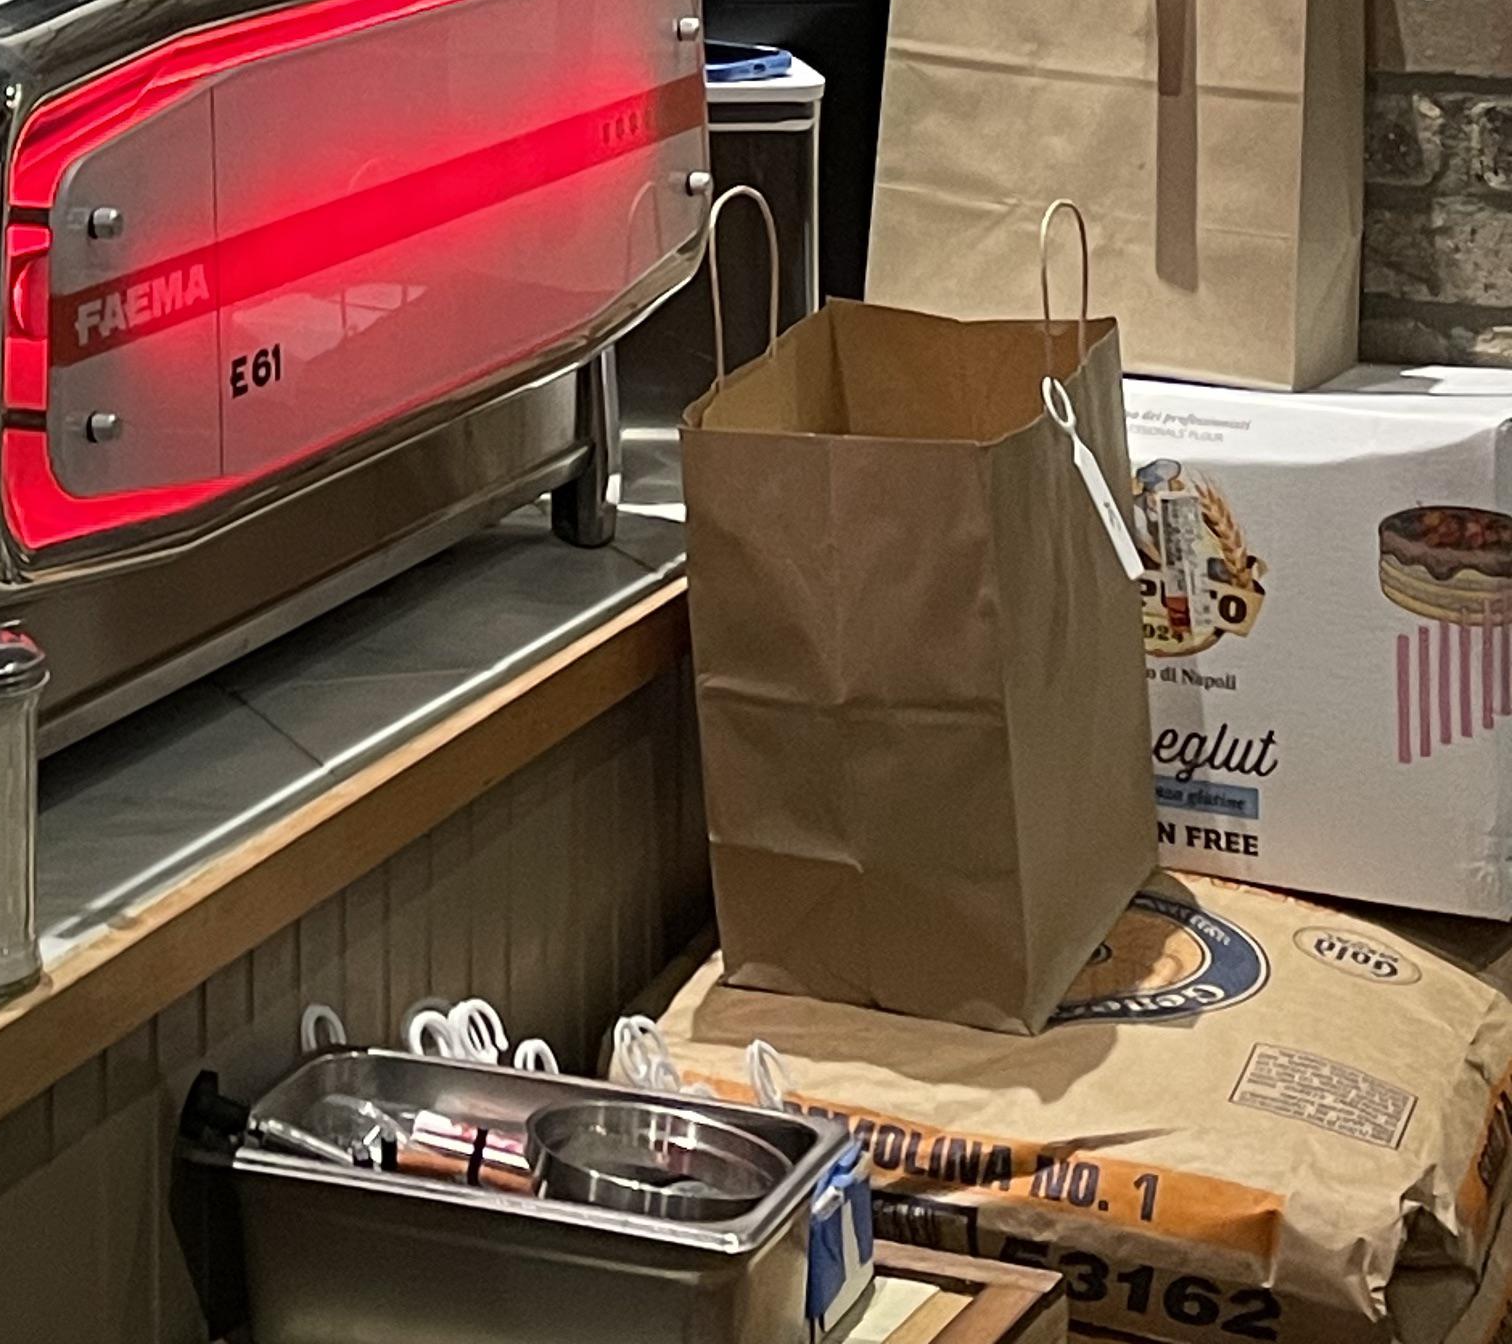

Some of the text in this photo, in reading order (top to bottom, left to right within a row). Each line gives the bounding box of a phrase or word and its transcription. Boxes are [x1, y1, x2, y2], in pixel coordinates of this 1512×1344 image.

[74, 263, 210, 347] FAEMA
[1180, 667, 1237, 691] Napoli
[1152, 723, 1279, 783] eglut
[1185, 825, 1259, 857] FREE
[1314, 938, 1399, 978] Gold
[1029, 1152, 1110, 1212] NO.
[1132, 1172, 1160, 1222] 1
